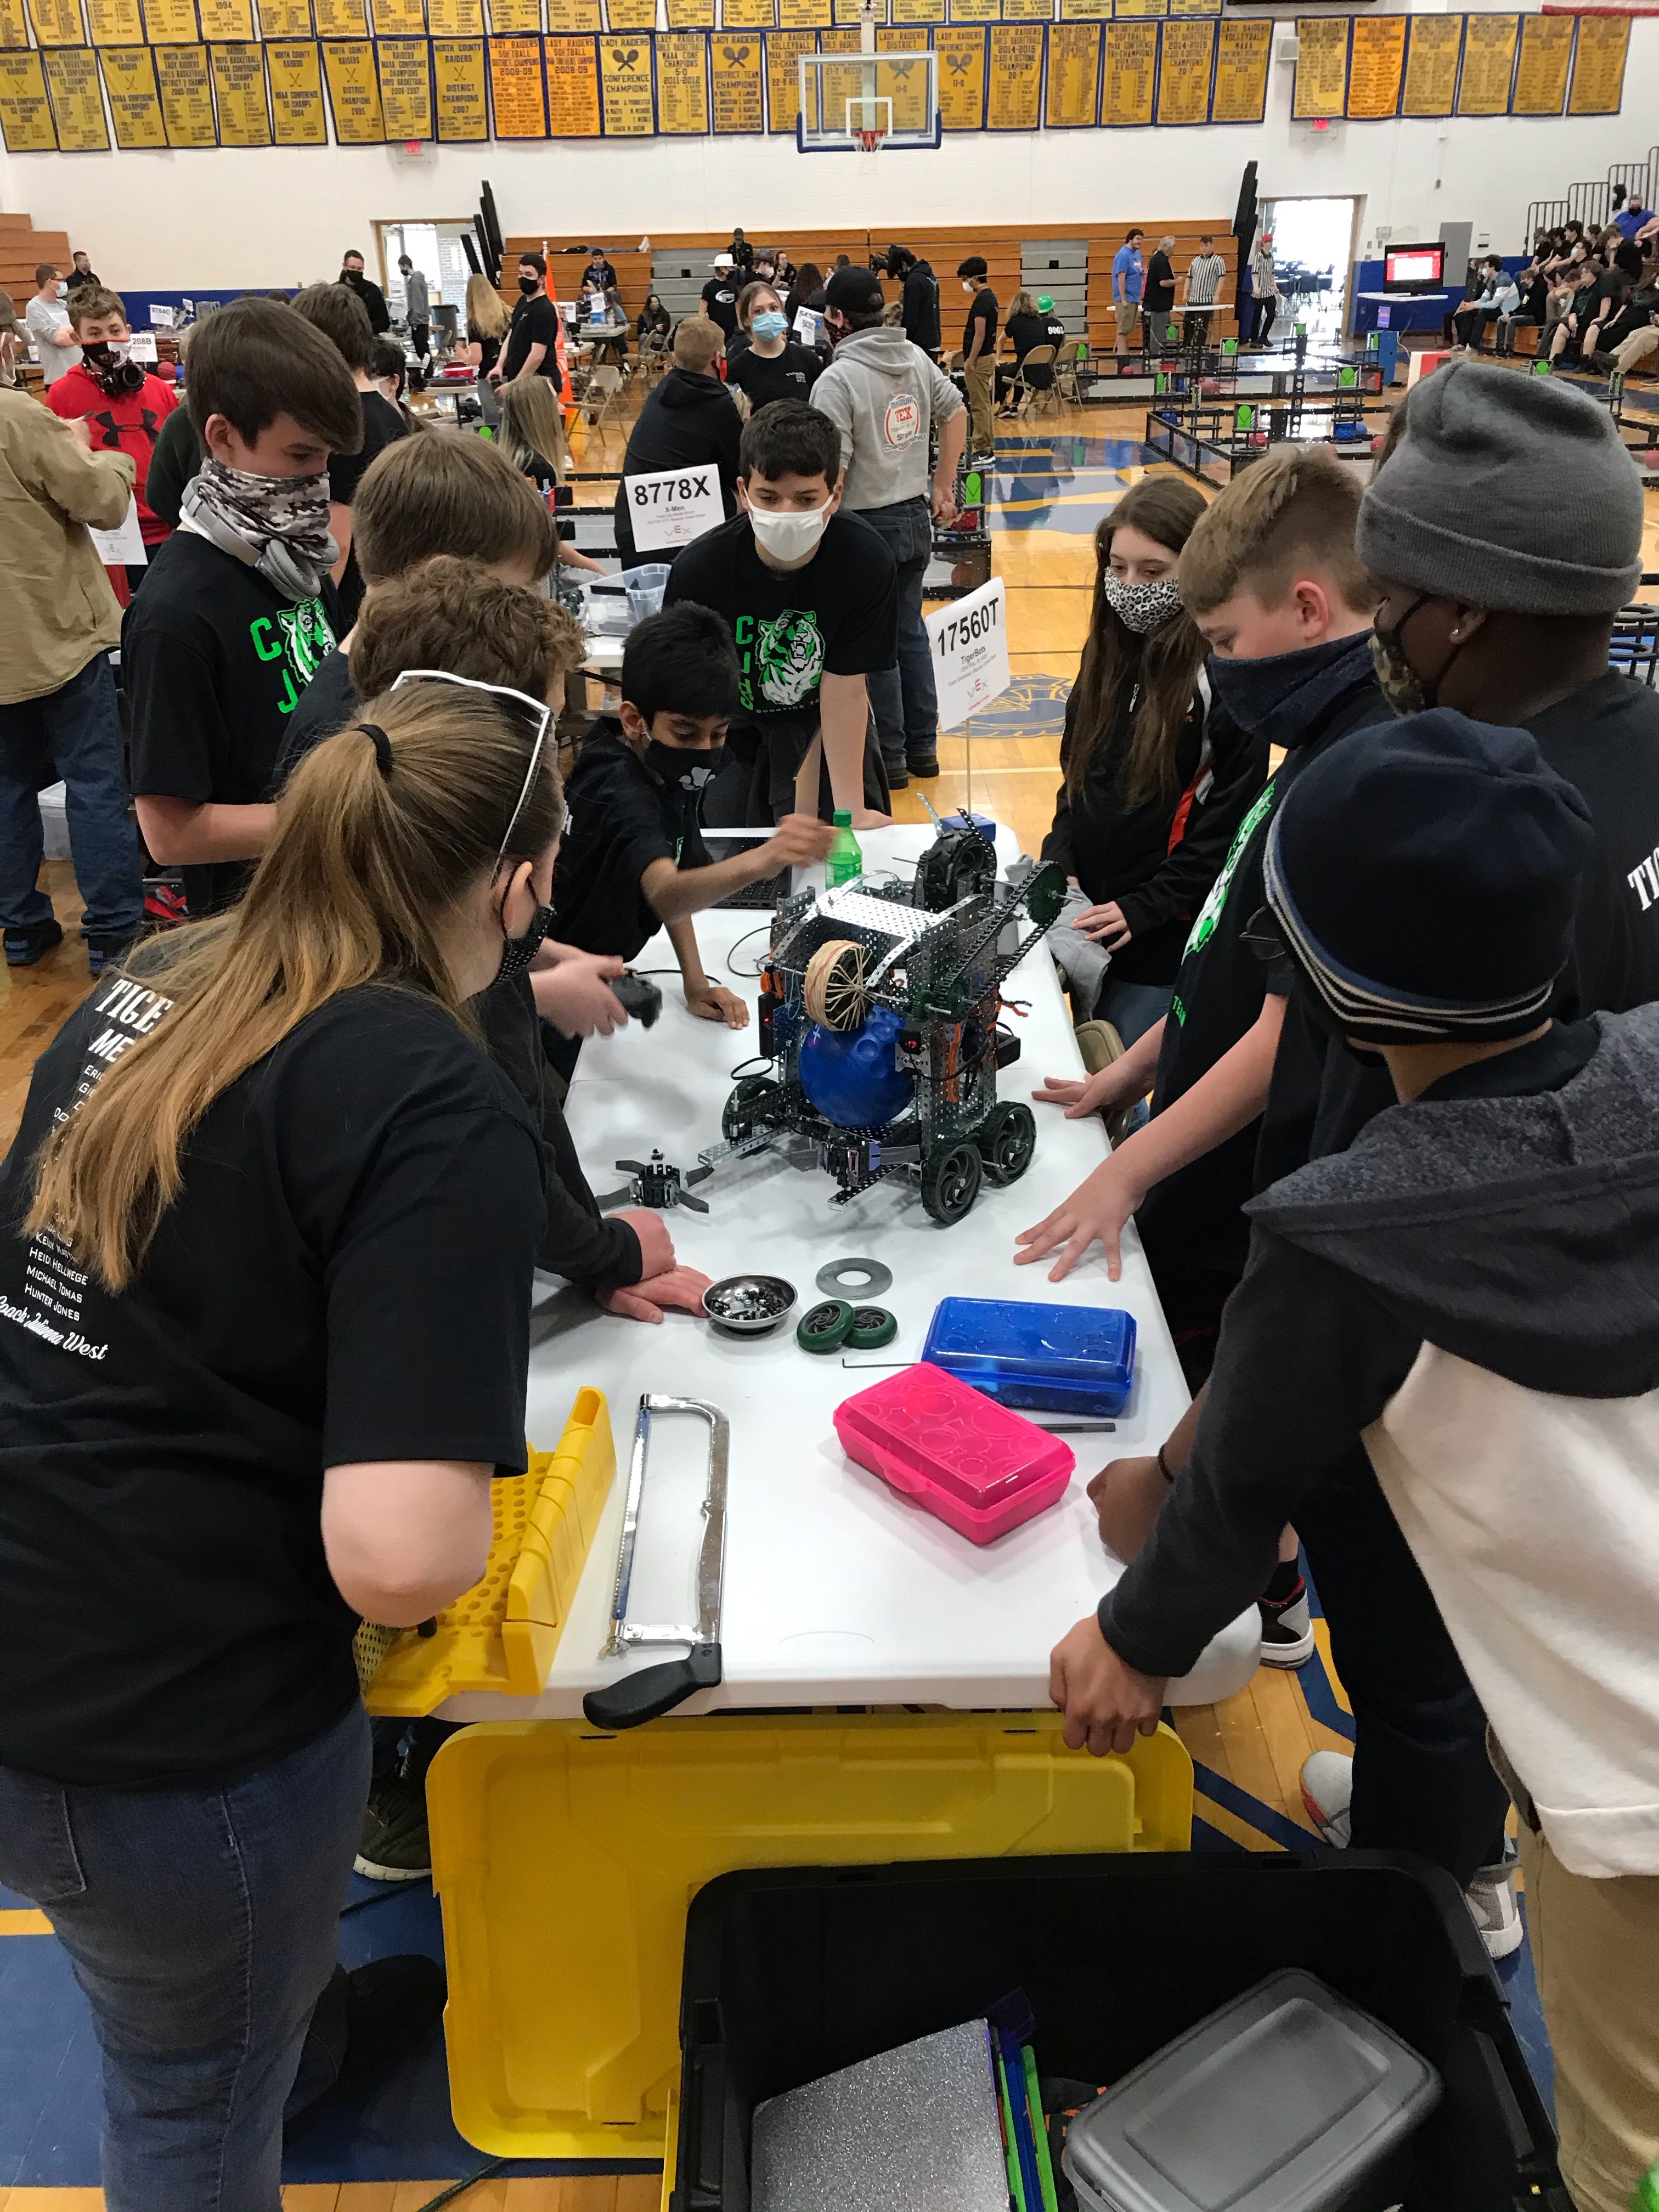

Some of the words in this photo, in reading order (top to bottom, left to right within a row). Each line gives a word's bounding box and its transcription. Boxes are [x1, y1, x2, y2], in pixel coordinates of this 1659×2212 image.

[621, 38, 649, 46] RAIDERS
[634, 475, 711, 506] 8778X
[664, 525, 692, 537] VEX
[938, 597, 999, 657] 17560T
[961, 645, 986, 665] TigerBots
[967, 678, 989, 698] VEX
[26, 1265, 57, 1291] MICHAEL
[58, 1282, 83, 1304] TOMAS
[52, 1258, 89, 1285] HELLWEGE
[24, 1283, 53, 1308] HUNTER
[53, 1300, 81, 1322] JONES
[63, 1331, 109, 1361] West
